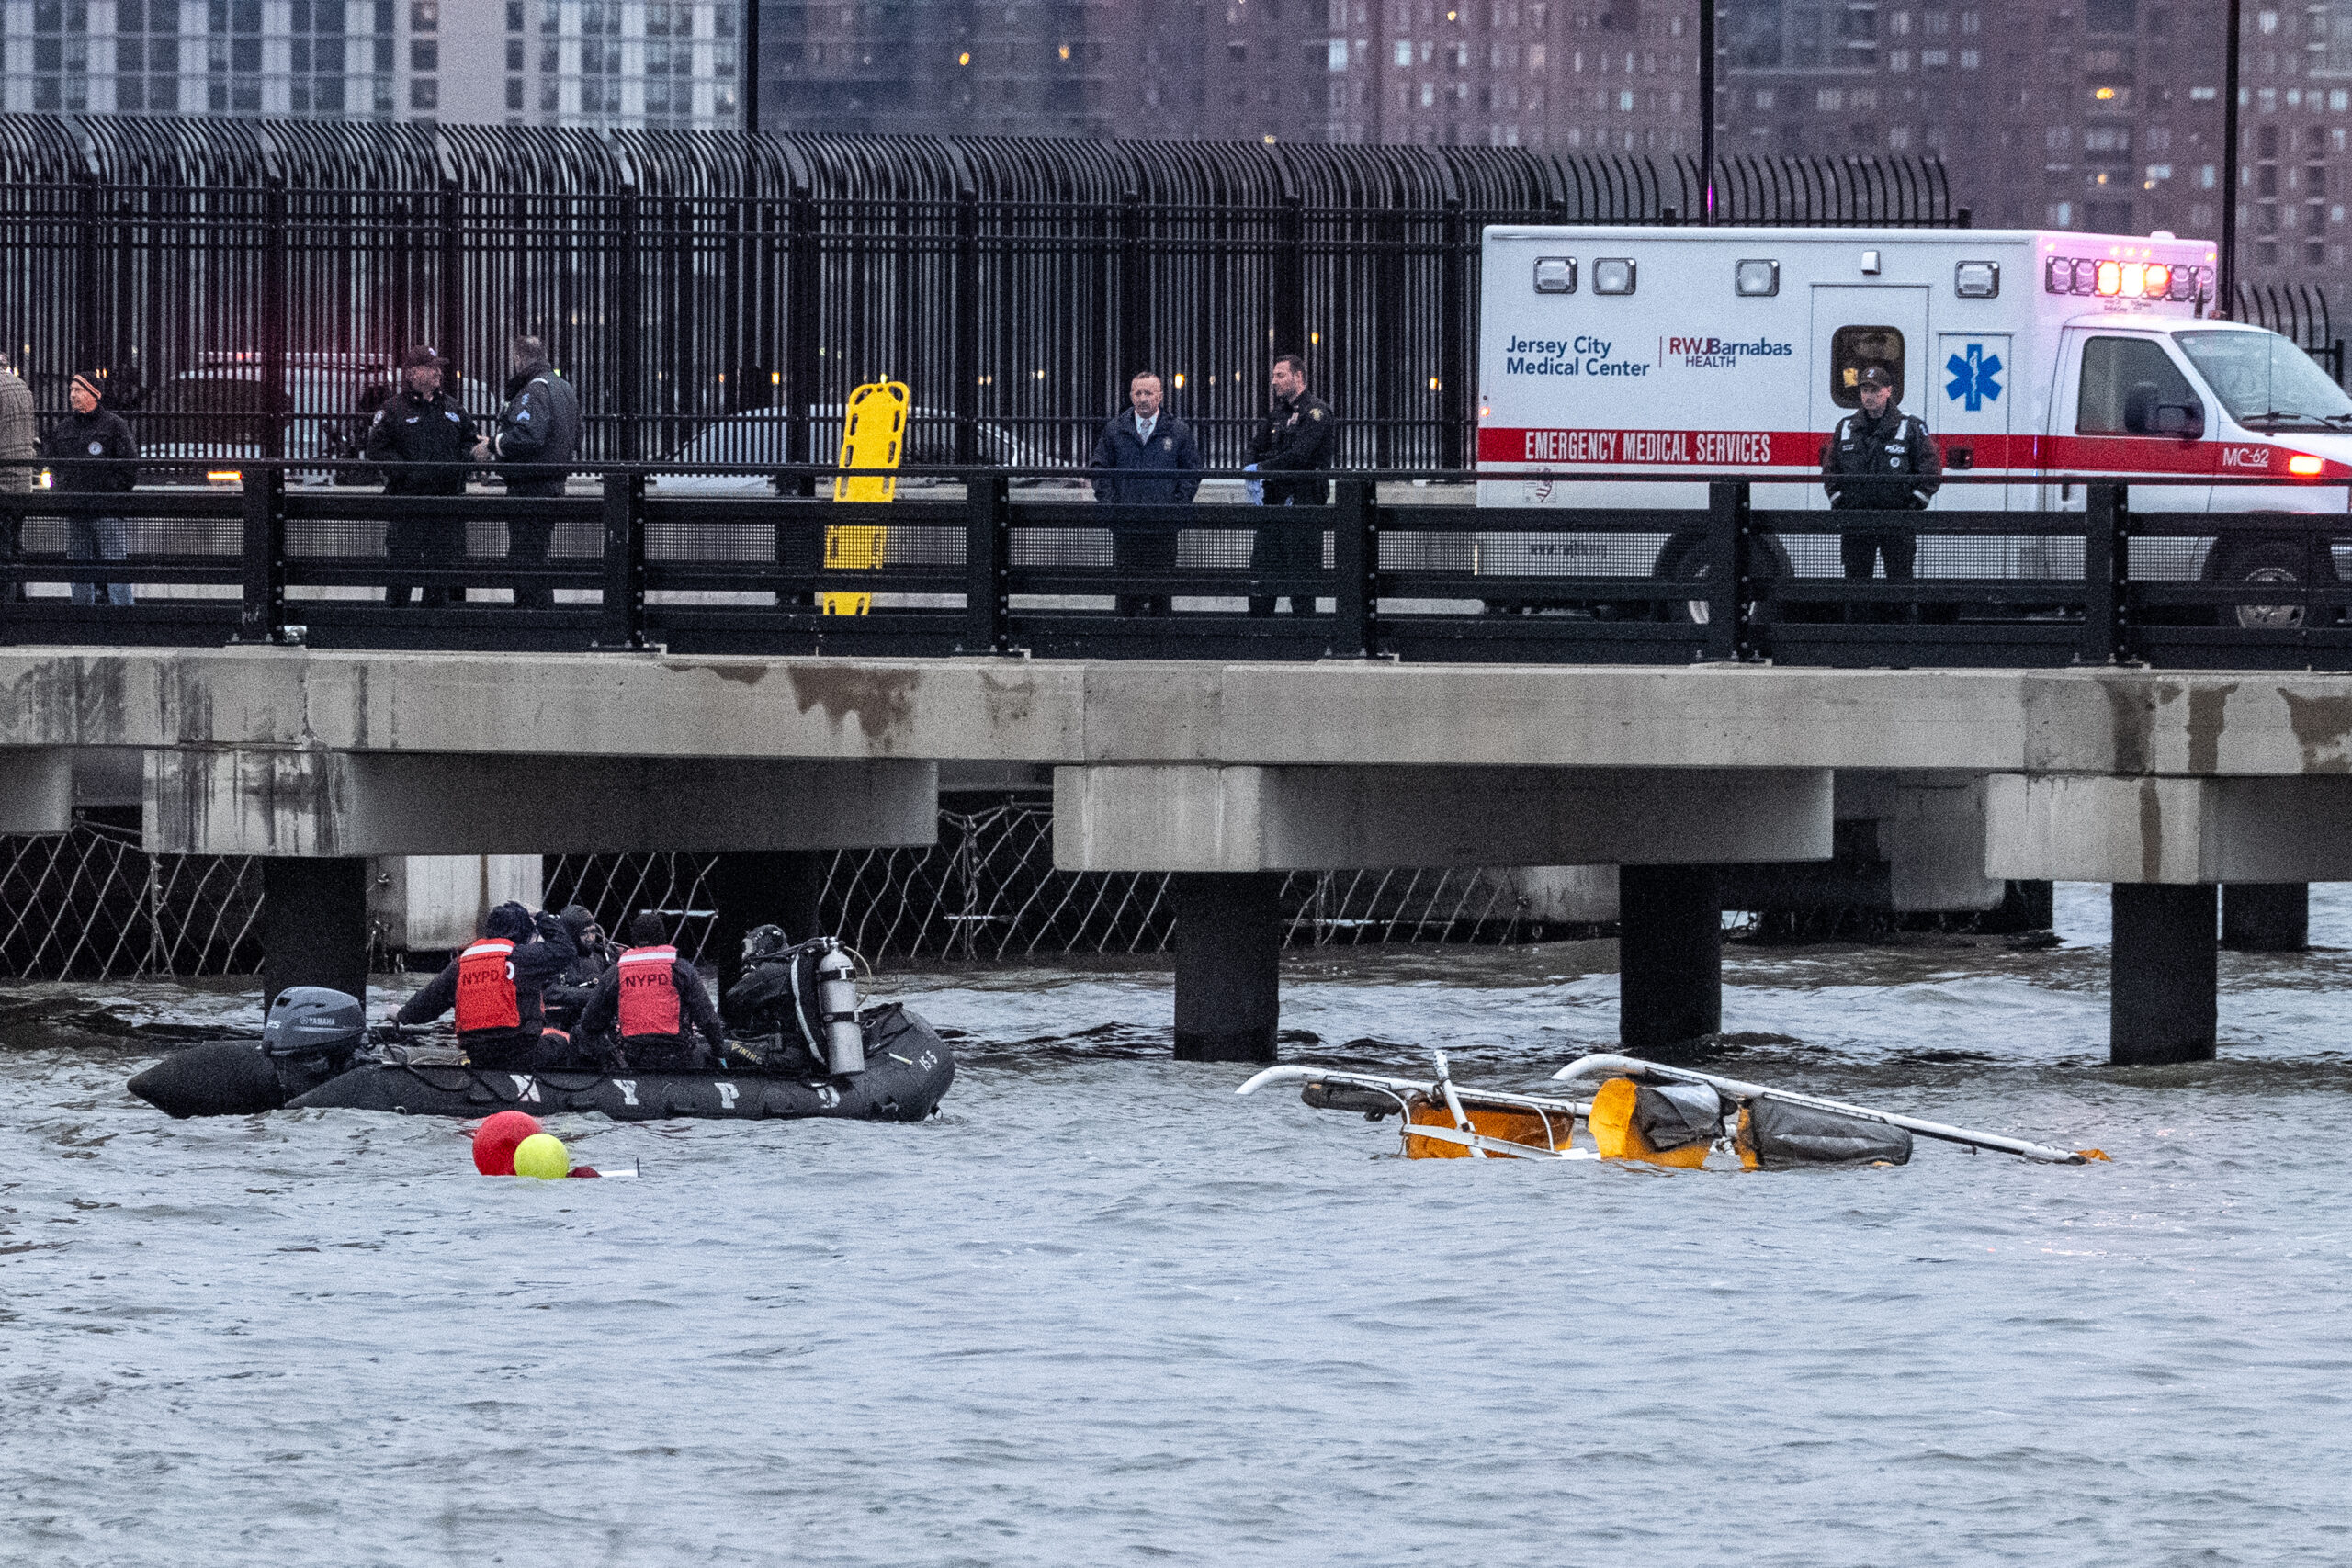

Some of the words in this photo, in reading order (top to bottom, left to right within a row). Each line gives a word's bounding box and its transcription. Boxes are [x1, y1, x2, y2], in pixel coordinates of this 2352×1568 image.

[1506, 335, 1568, 358] Jersey
[1573, 336, 1612, 359] City
[1506, 357, 1579, 376] Medical
[1586, 358, 1650, 377] Center
[1685, 355, 1736, 368] HEALTH
[1525, 431, 1618, 460] EMERGENCY
[1623, 432, 1690, 462] MEDICAL
[1696, 434, 1770, 463] SERVICES
[2222, 447, 2269, 468] MC-62
[462, 969, 500, 986] NYPD
[625, 973, 669, 987] NYPD
[309, 1017, 335, 1026] YAMAHA
